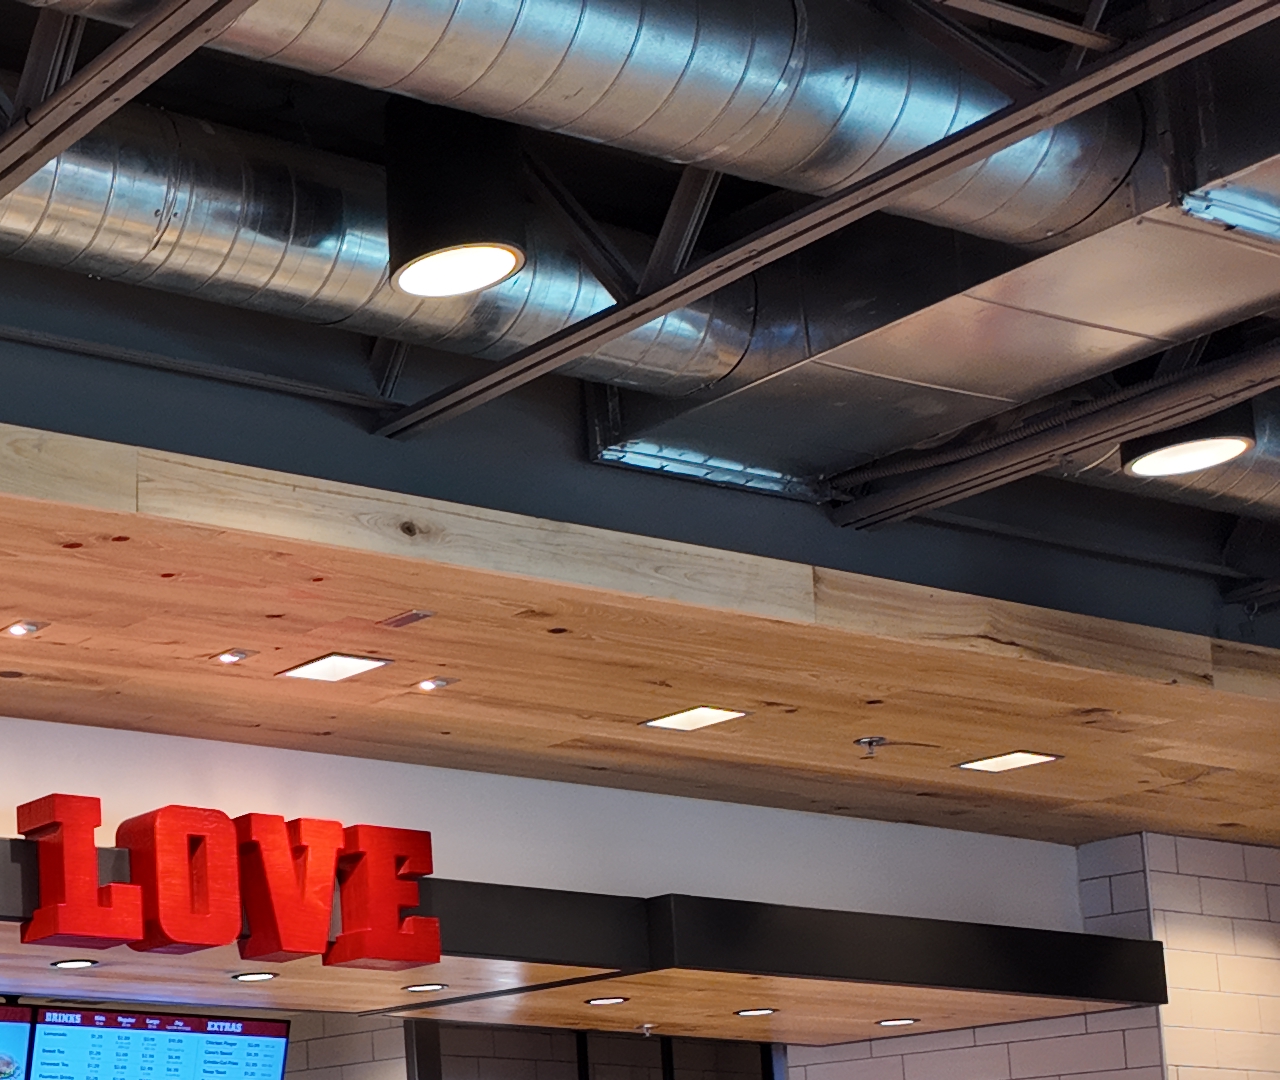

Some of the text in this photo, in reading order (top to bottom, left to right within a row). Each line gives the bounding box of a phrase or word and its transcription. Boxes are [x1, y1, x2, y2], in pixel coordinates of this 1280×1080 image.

[17, 792, 441, 970] LOVE
[45, 1012, 82, 1024] DRINKS
[206, 1021, 243, 1033] EXTRAS
